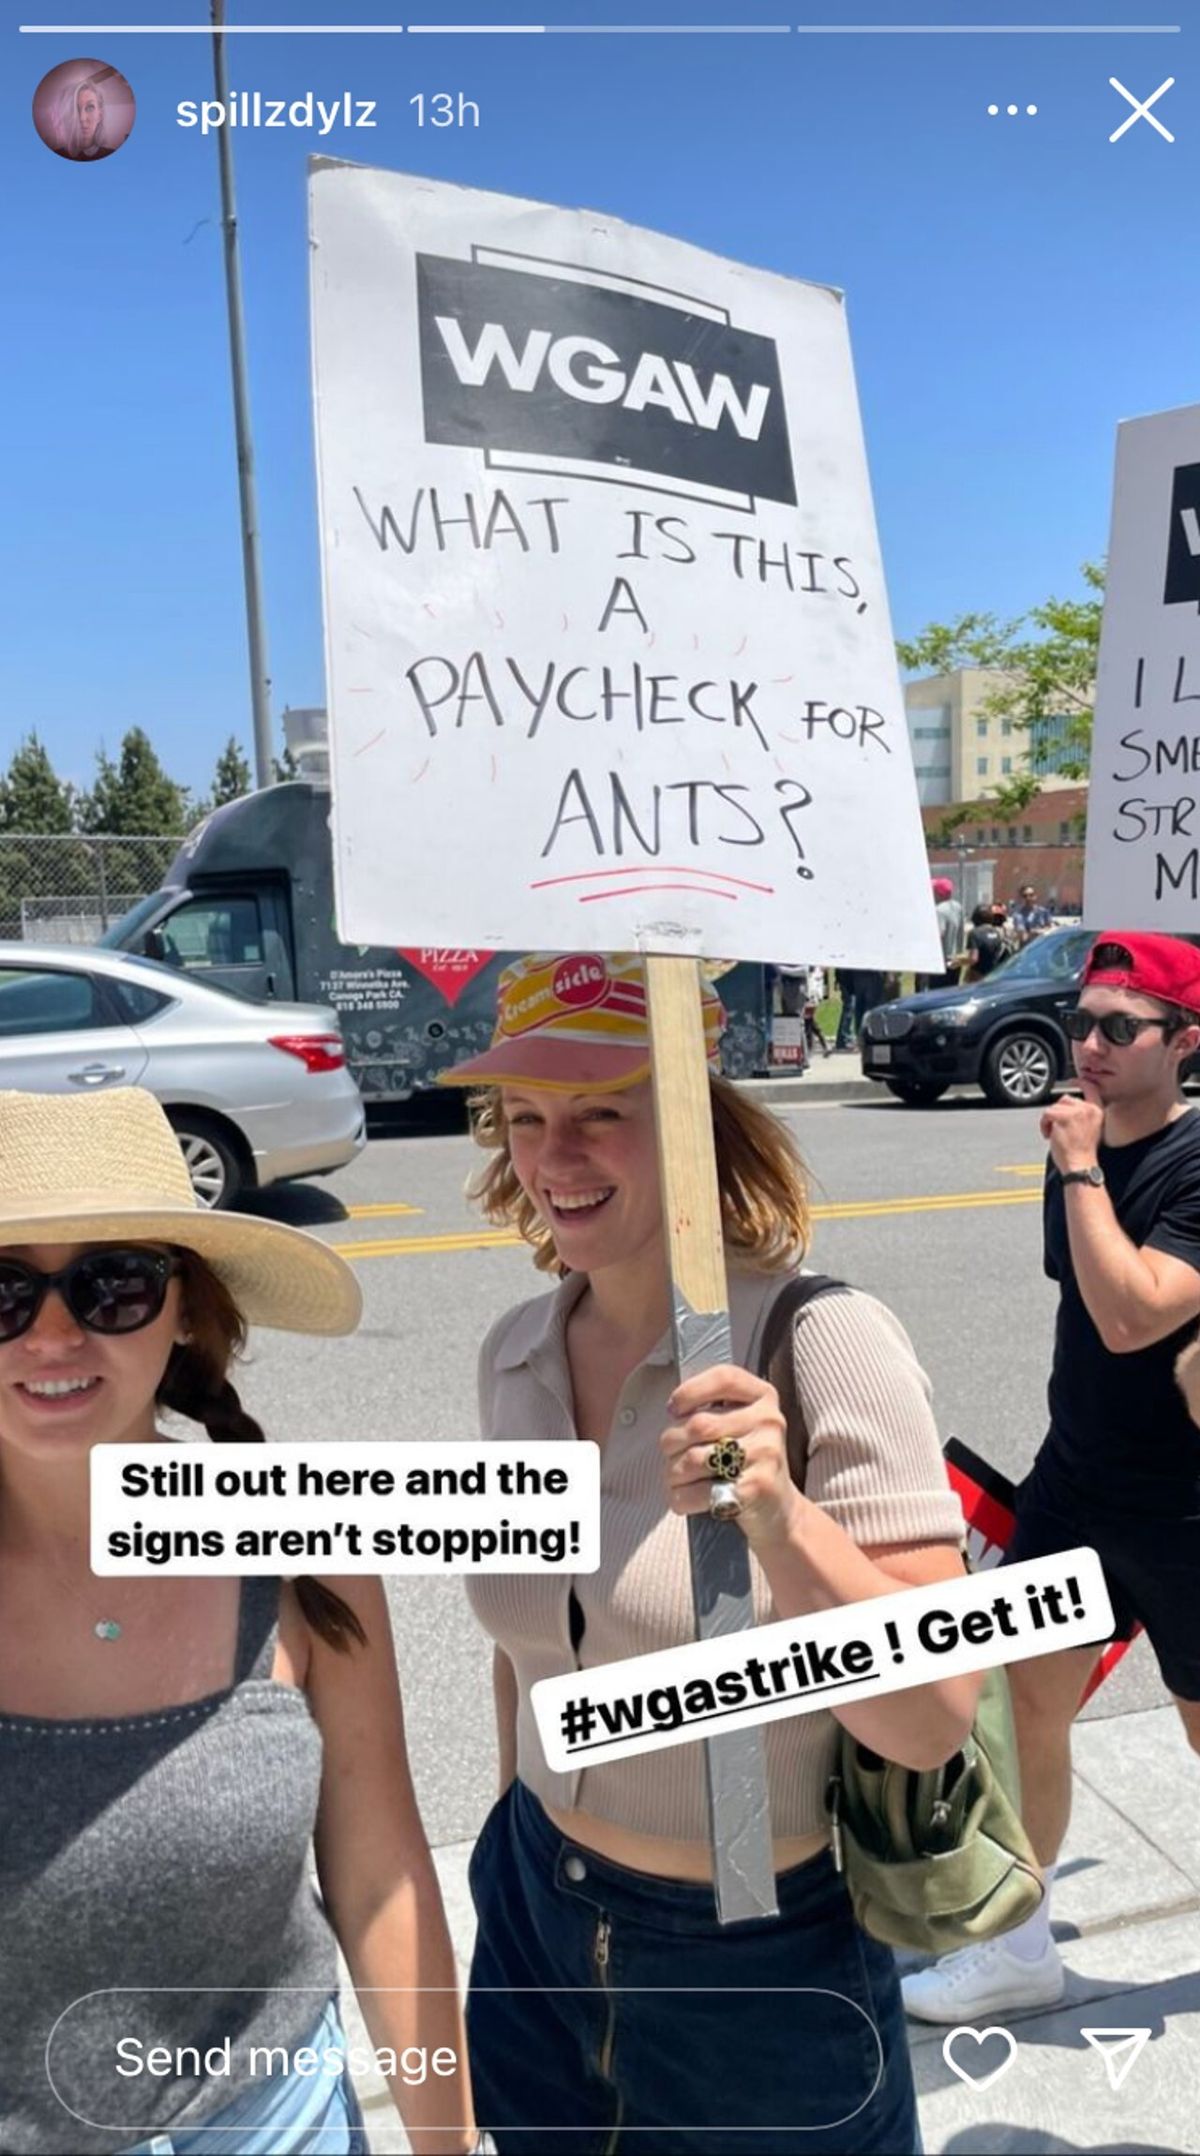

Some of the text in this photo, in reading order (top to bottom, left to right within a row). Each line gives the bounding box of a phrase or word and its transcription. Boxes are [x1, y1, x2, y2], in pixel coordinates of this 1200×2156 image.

[434, 316, 771, 441] WGAW
[353, 485, 569, 555] WHAT
[616, 510, 696, 563] IS
[597, 576, 649, 634] A
[405, 651, 892, 754] PAYCHECK FOR
[540, 768, 815, 880] ANTS?
